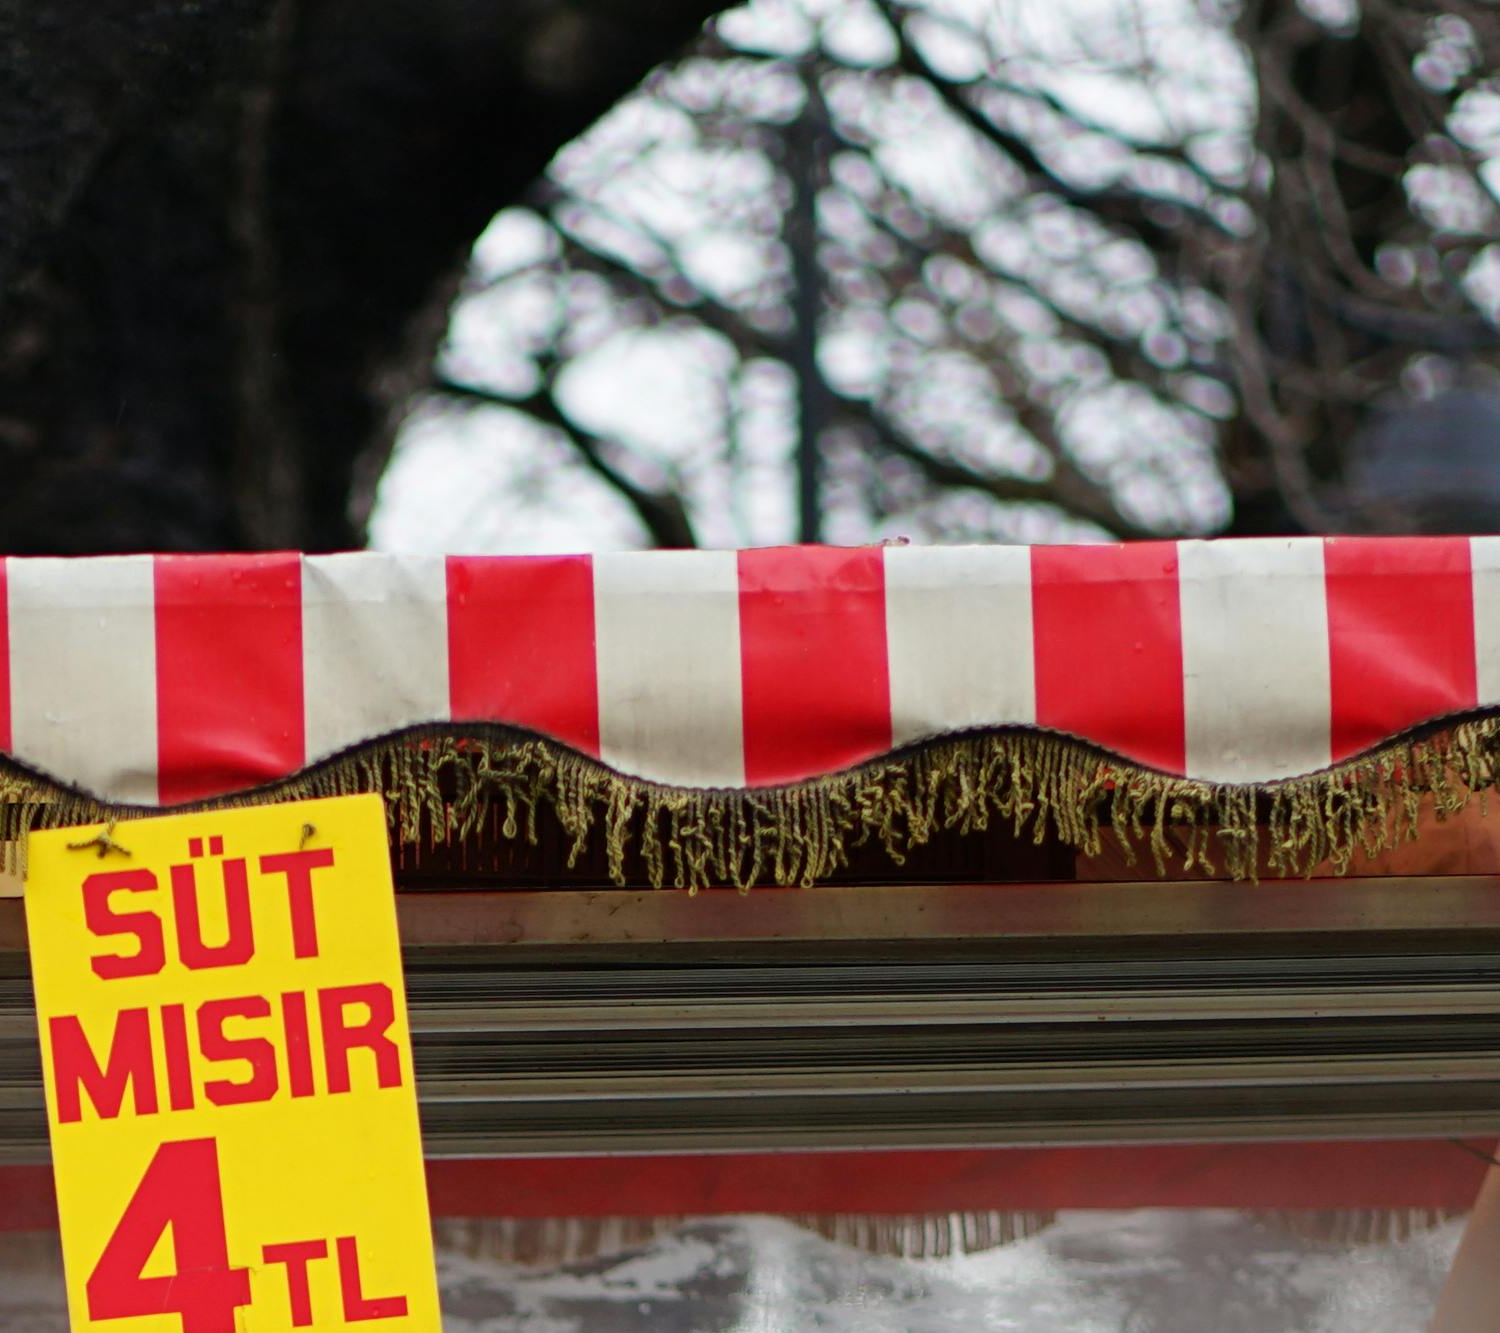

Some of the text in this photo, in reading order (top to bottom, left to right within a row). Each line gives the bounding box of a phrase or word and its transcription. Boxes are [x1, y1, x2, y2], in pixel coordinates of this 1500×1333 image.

[82, 835, 334, 980] SÜT
[49, 982, 402, 1123] MISIR
[262, 1236, 408, 1328] TL
